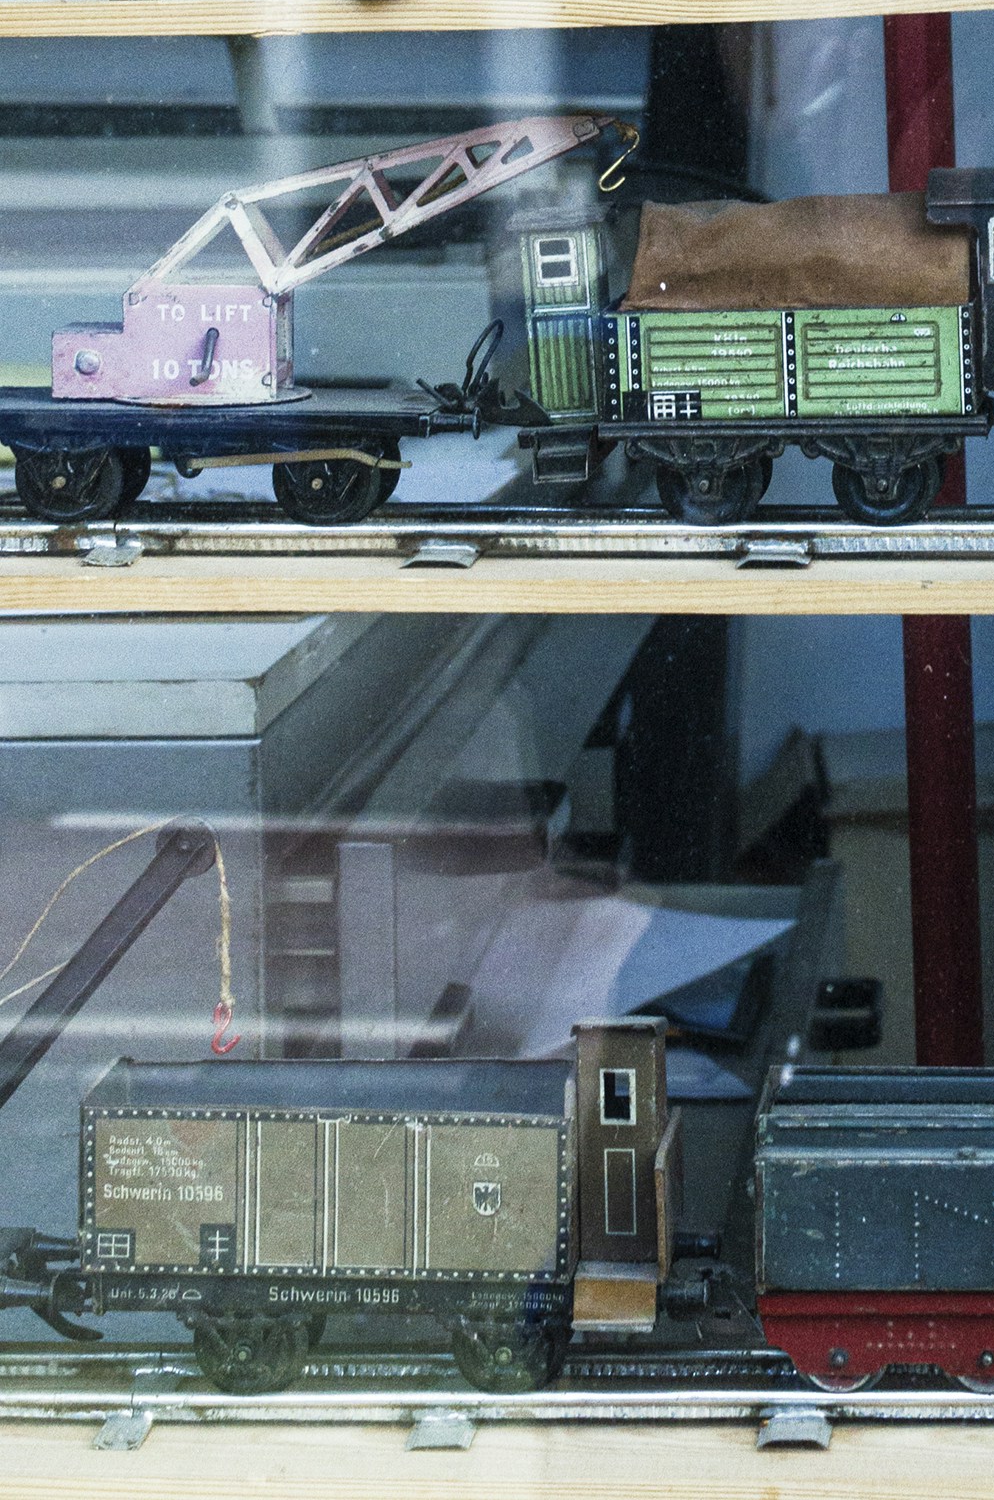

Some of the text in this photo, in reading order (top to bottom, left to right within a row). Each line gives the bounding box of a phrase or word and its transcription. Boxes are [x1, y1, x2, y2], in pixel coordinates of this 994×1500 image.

[157, 303, 252, 322] TO LIFT
[152, 359, 180, 380] 10
[103, 1182, 224, 1202] Schwerin 10596
[268, 1286, 347, 1302] Schwerin
[356, 1288, 400, 1303] 10596
